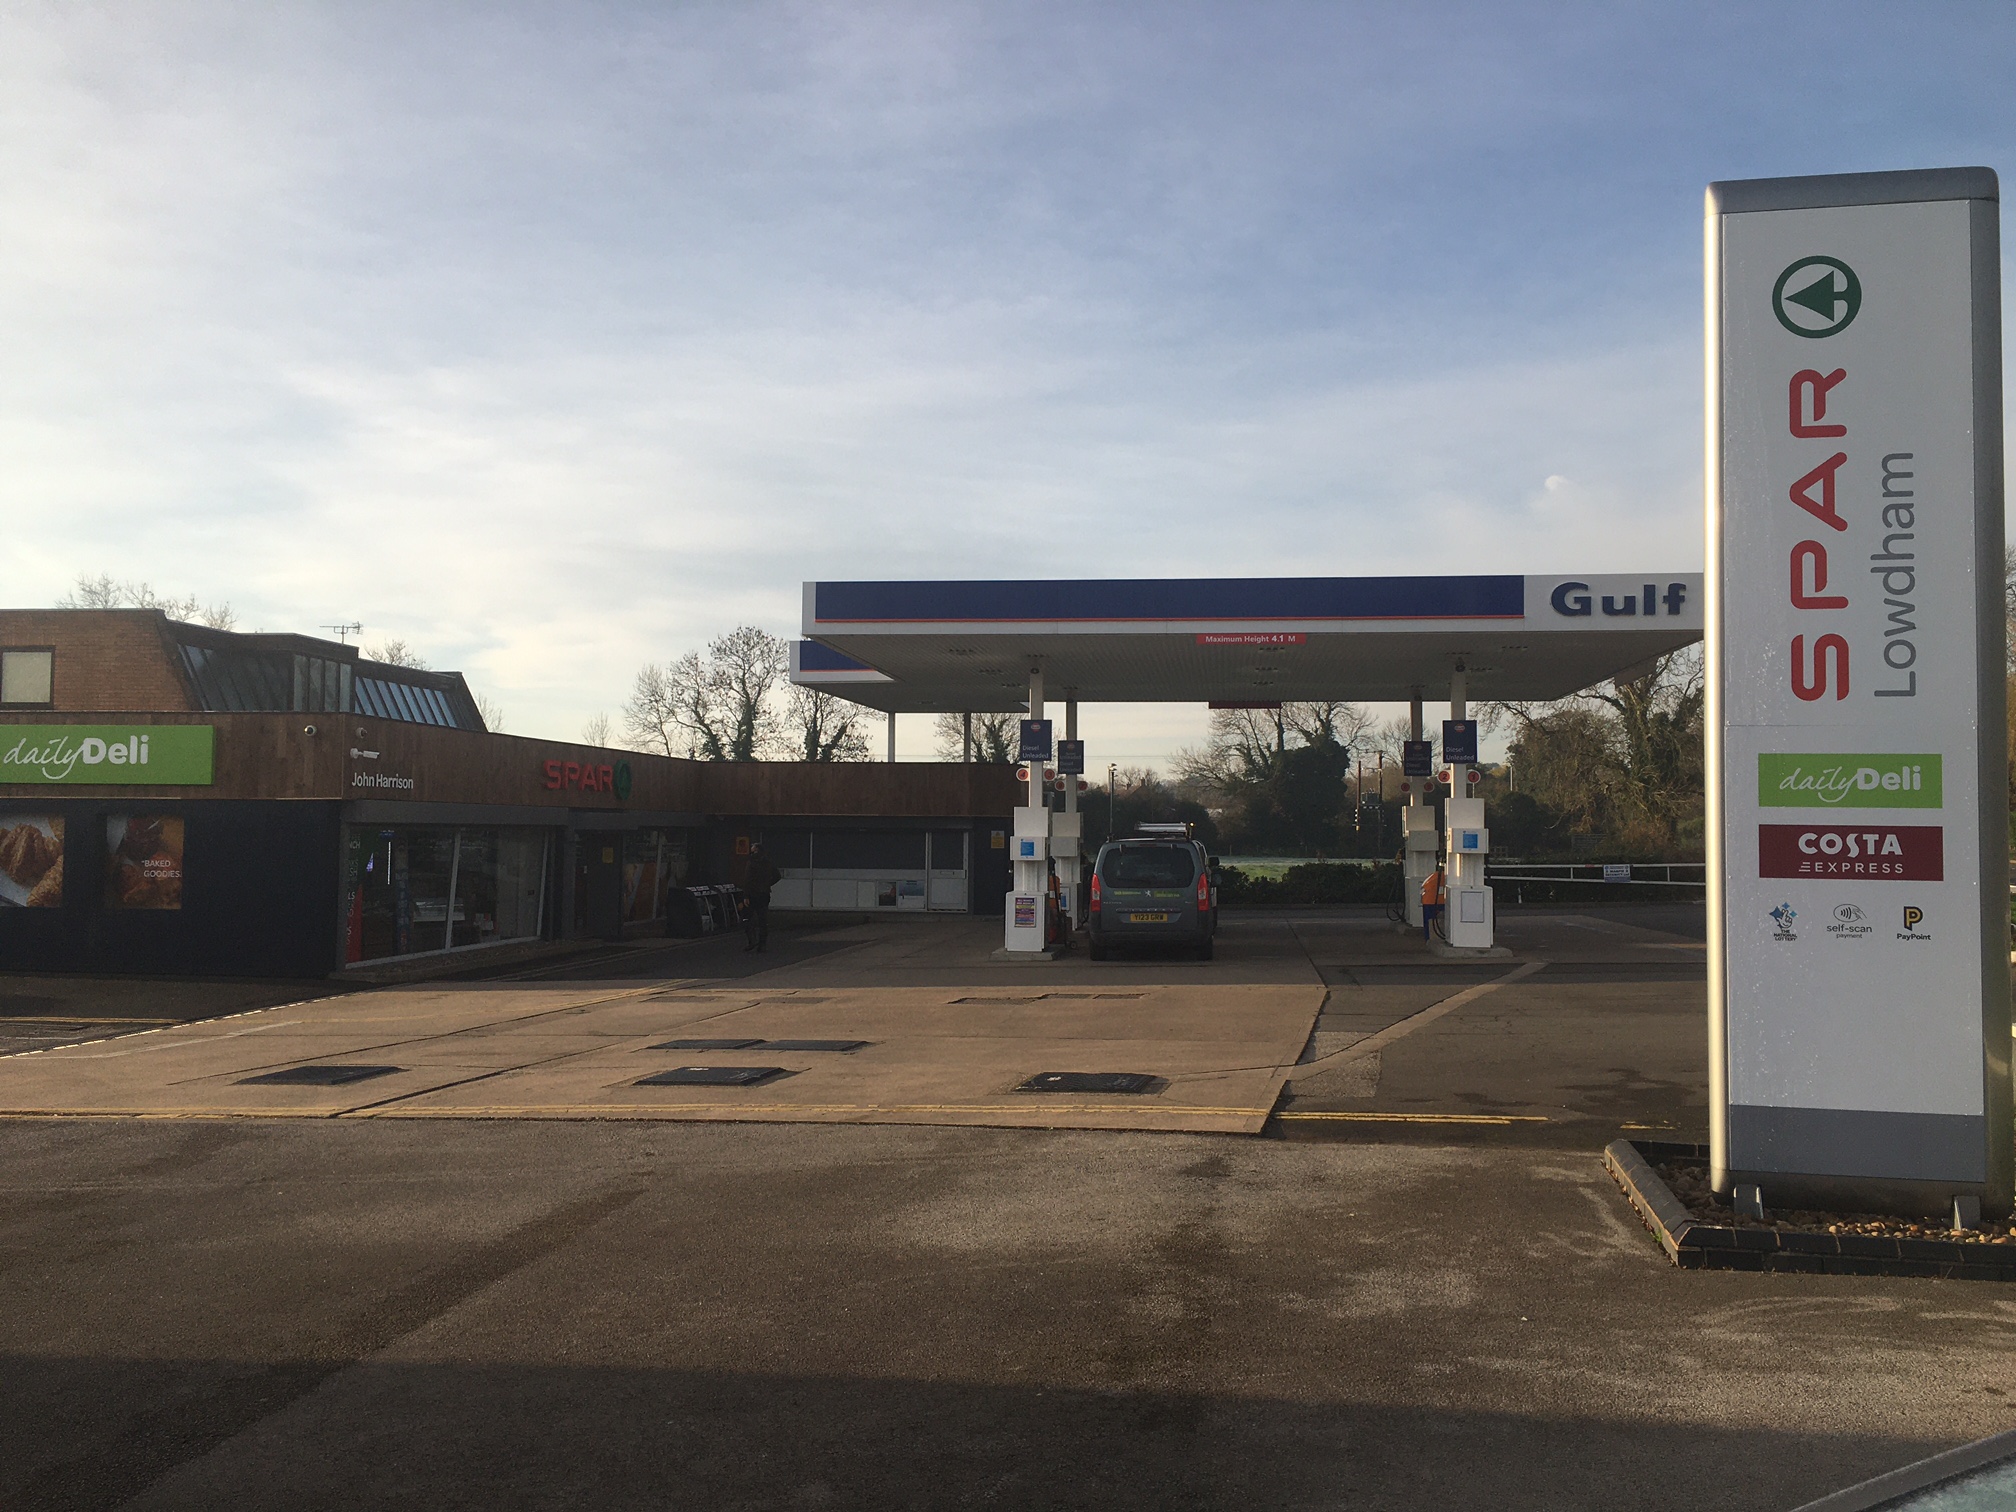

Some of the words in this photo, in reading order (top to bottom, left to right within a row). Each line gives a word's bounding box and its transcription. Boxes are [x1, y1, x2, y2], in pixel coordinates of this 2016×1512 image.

[1788, 367, 1849, 701] SPAR
[1870, 452, 1917, 697] Lowdham
[1551, 581, 1687, 617] Gulf
[1205, 635, 1242, 643] Maximum
[1244, 635, 1269, 644] Height
[1271, 634, 1284, 643] 4.1
[1288, 635, 1296, 643] M
[351, 772, 375, 788] John
[376, 773, 414, 789] Harrison
[543, 759, 614, 792] SPAR
[1798, 832, 1904, 858] COSTA
[1815, 862, 1904, 873] EXPRESS
[1826, 924, 1873, 933] self-scan
[1896, 933, 1931, 941] PayPoint
